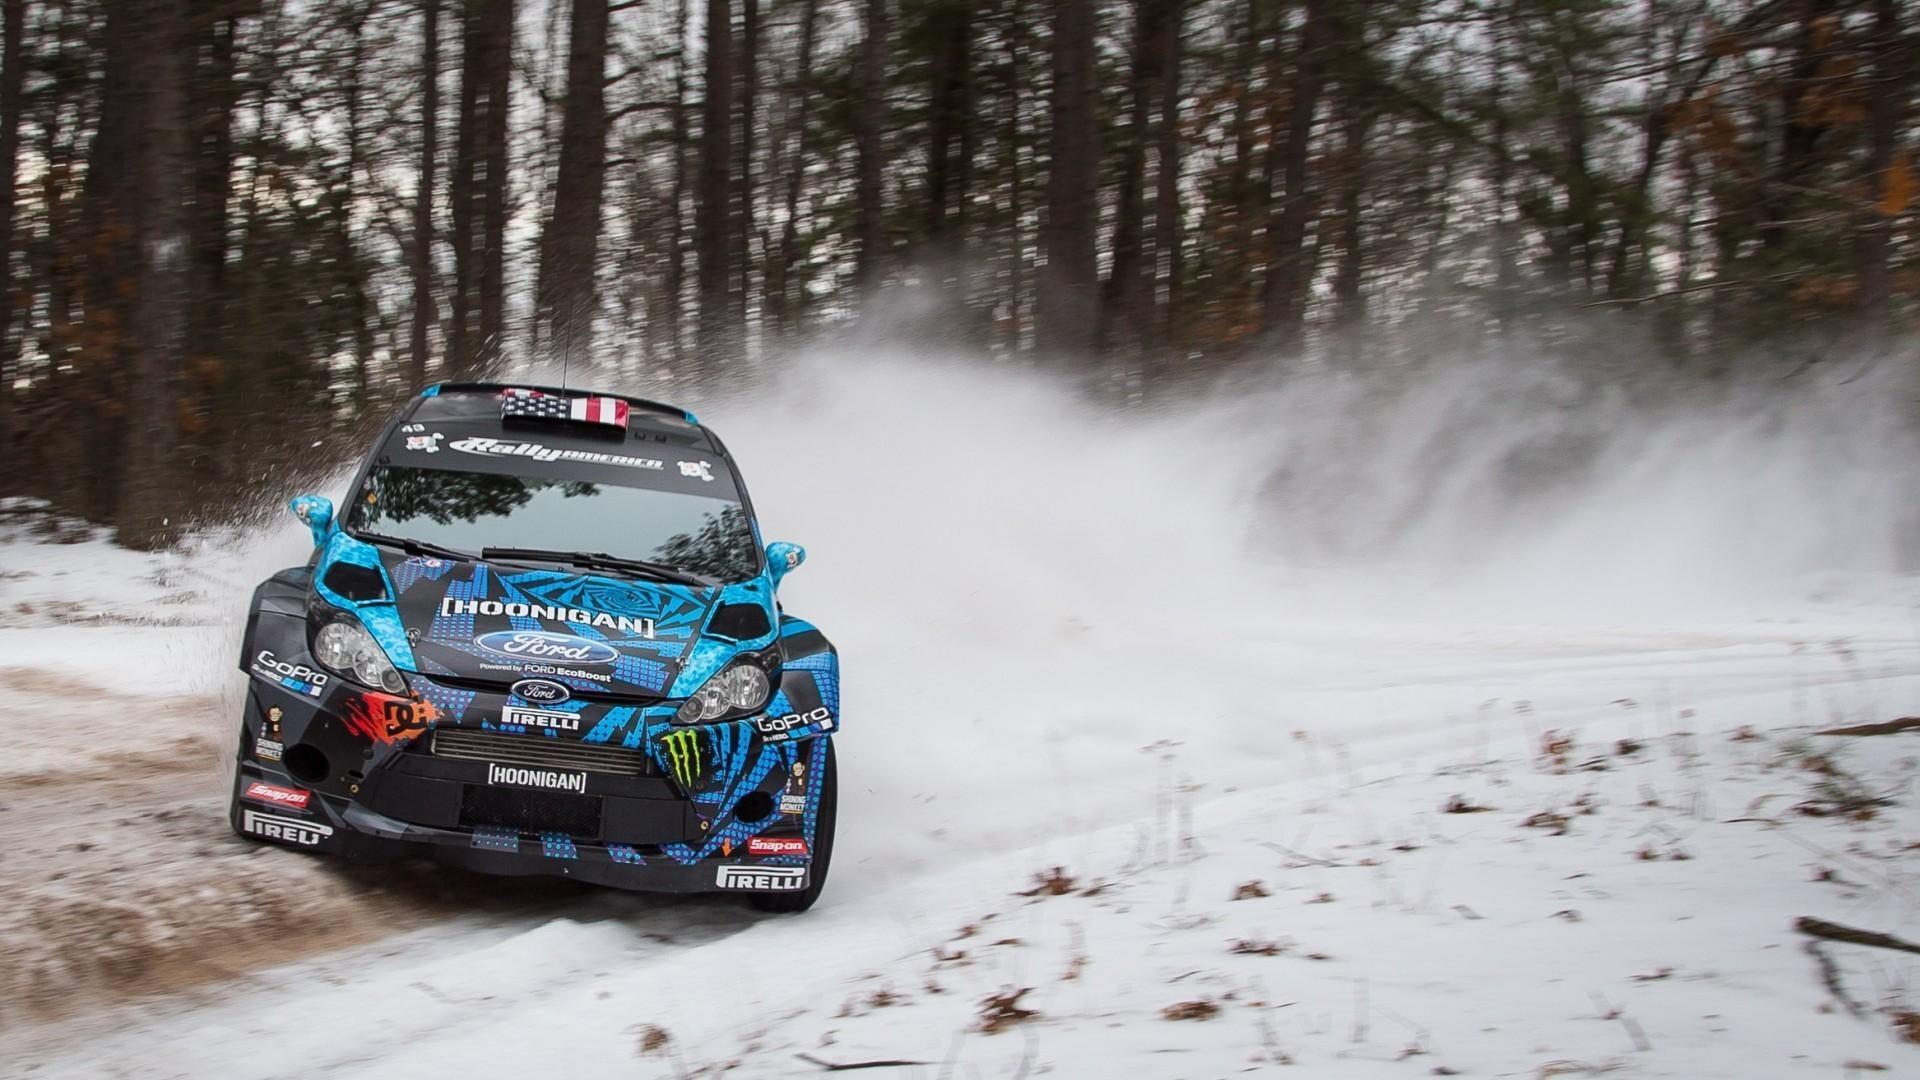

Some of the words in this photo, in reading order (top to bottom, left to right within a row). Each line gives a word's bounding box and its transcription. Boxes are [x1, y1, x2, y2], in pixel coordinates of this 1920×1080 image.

[441, 597, 655, 639] [HOONIGAN]
[503, 633, 590, 660] Ford
[257, 650, 328, 685] GoPro
[479, 663, 510, 672] Powered
[512, 665, 522, 673] by
[524, 664, 556, 675] FORD
[557, 668, 612, 683] EcoBoost
[523, 684, 555, 699] Ford
[501, 705, 580, 730] PIRELLI
[757, 707, 829, 732] GoPro
[488, 763, 587, 794] [HOONIGAN]
[250, 785, 307, 803] Snap-on
[750, 839, 803, 852] Snap-on
[716, 865, 805, 889] PIRELLI
